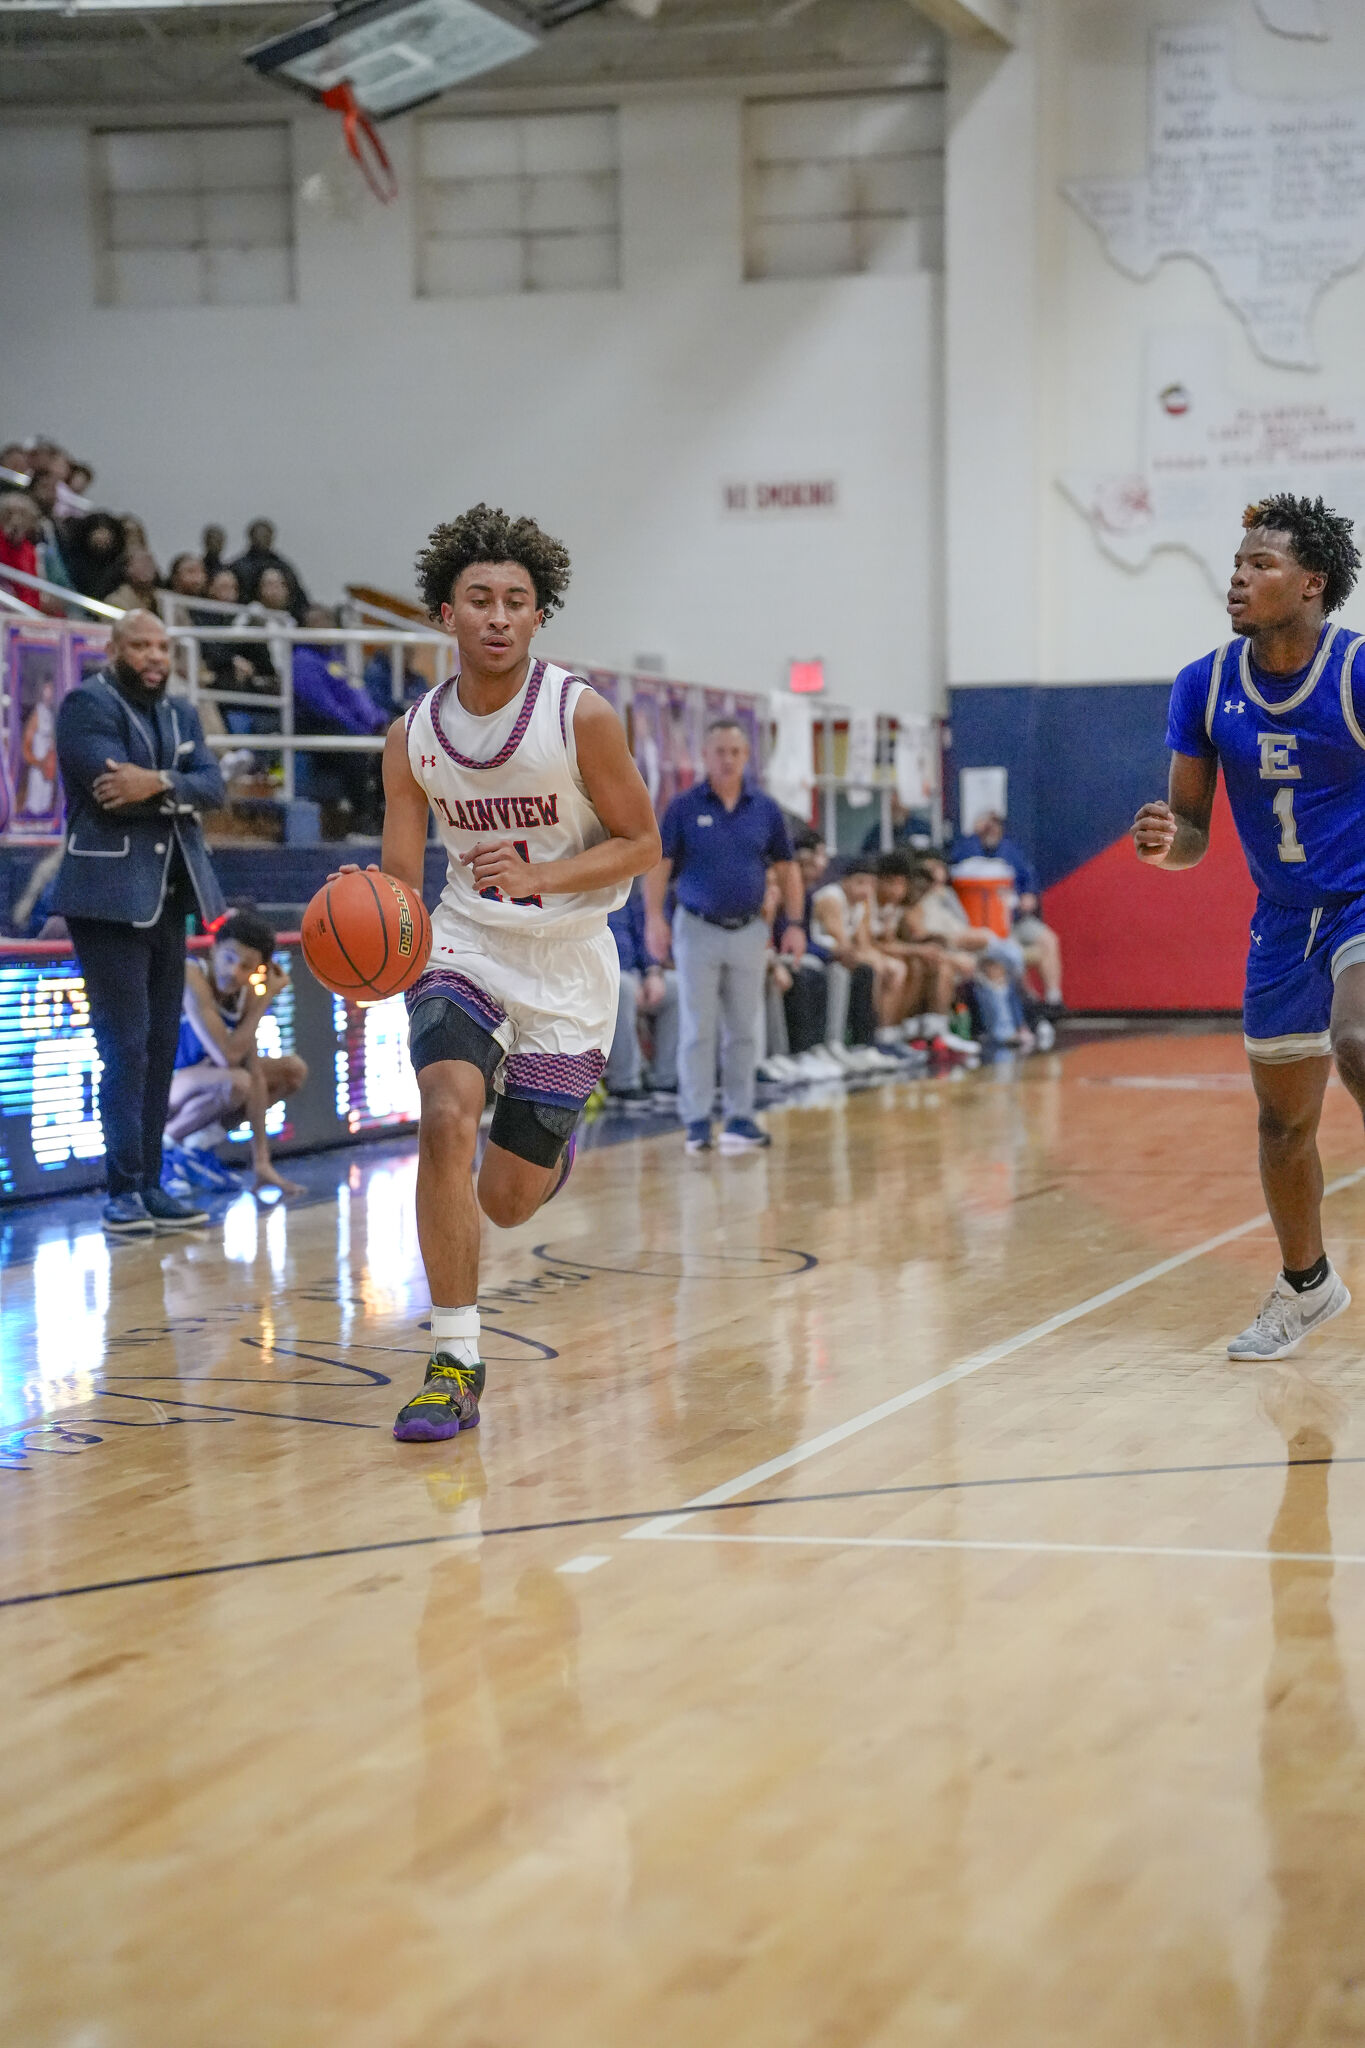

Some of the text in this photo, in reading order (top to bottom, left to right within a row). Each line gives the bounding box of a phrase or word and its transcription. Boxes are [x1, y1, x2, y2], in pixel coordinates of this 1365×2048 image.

[1257, 732, 1303, 780] E
[433, 793, 560, 832] LAINVIEW
[1272, 787, 1307, 863] 1
